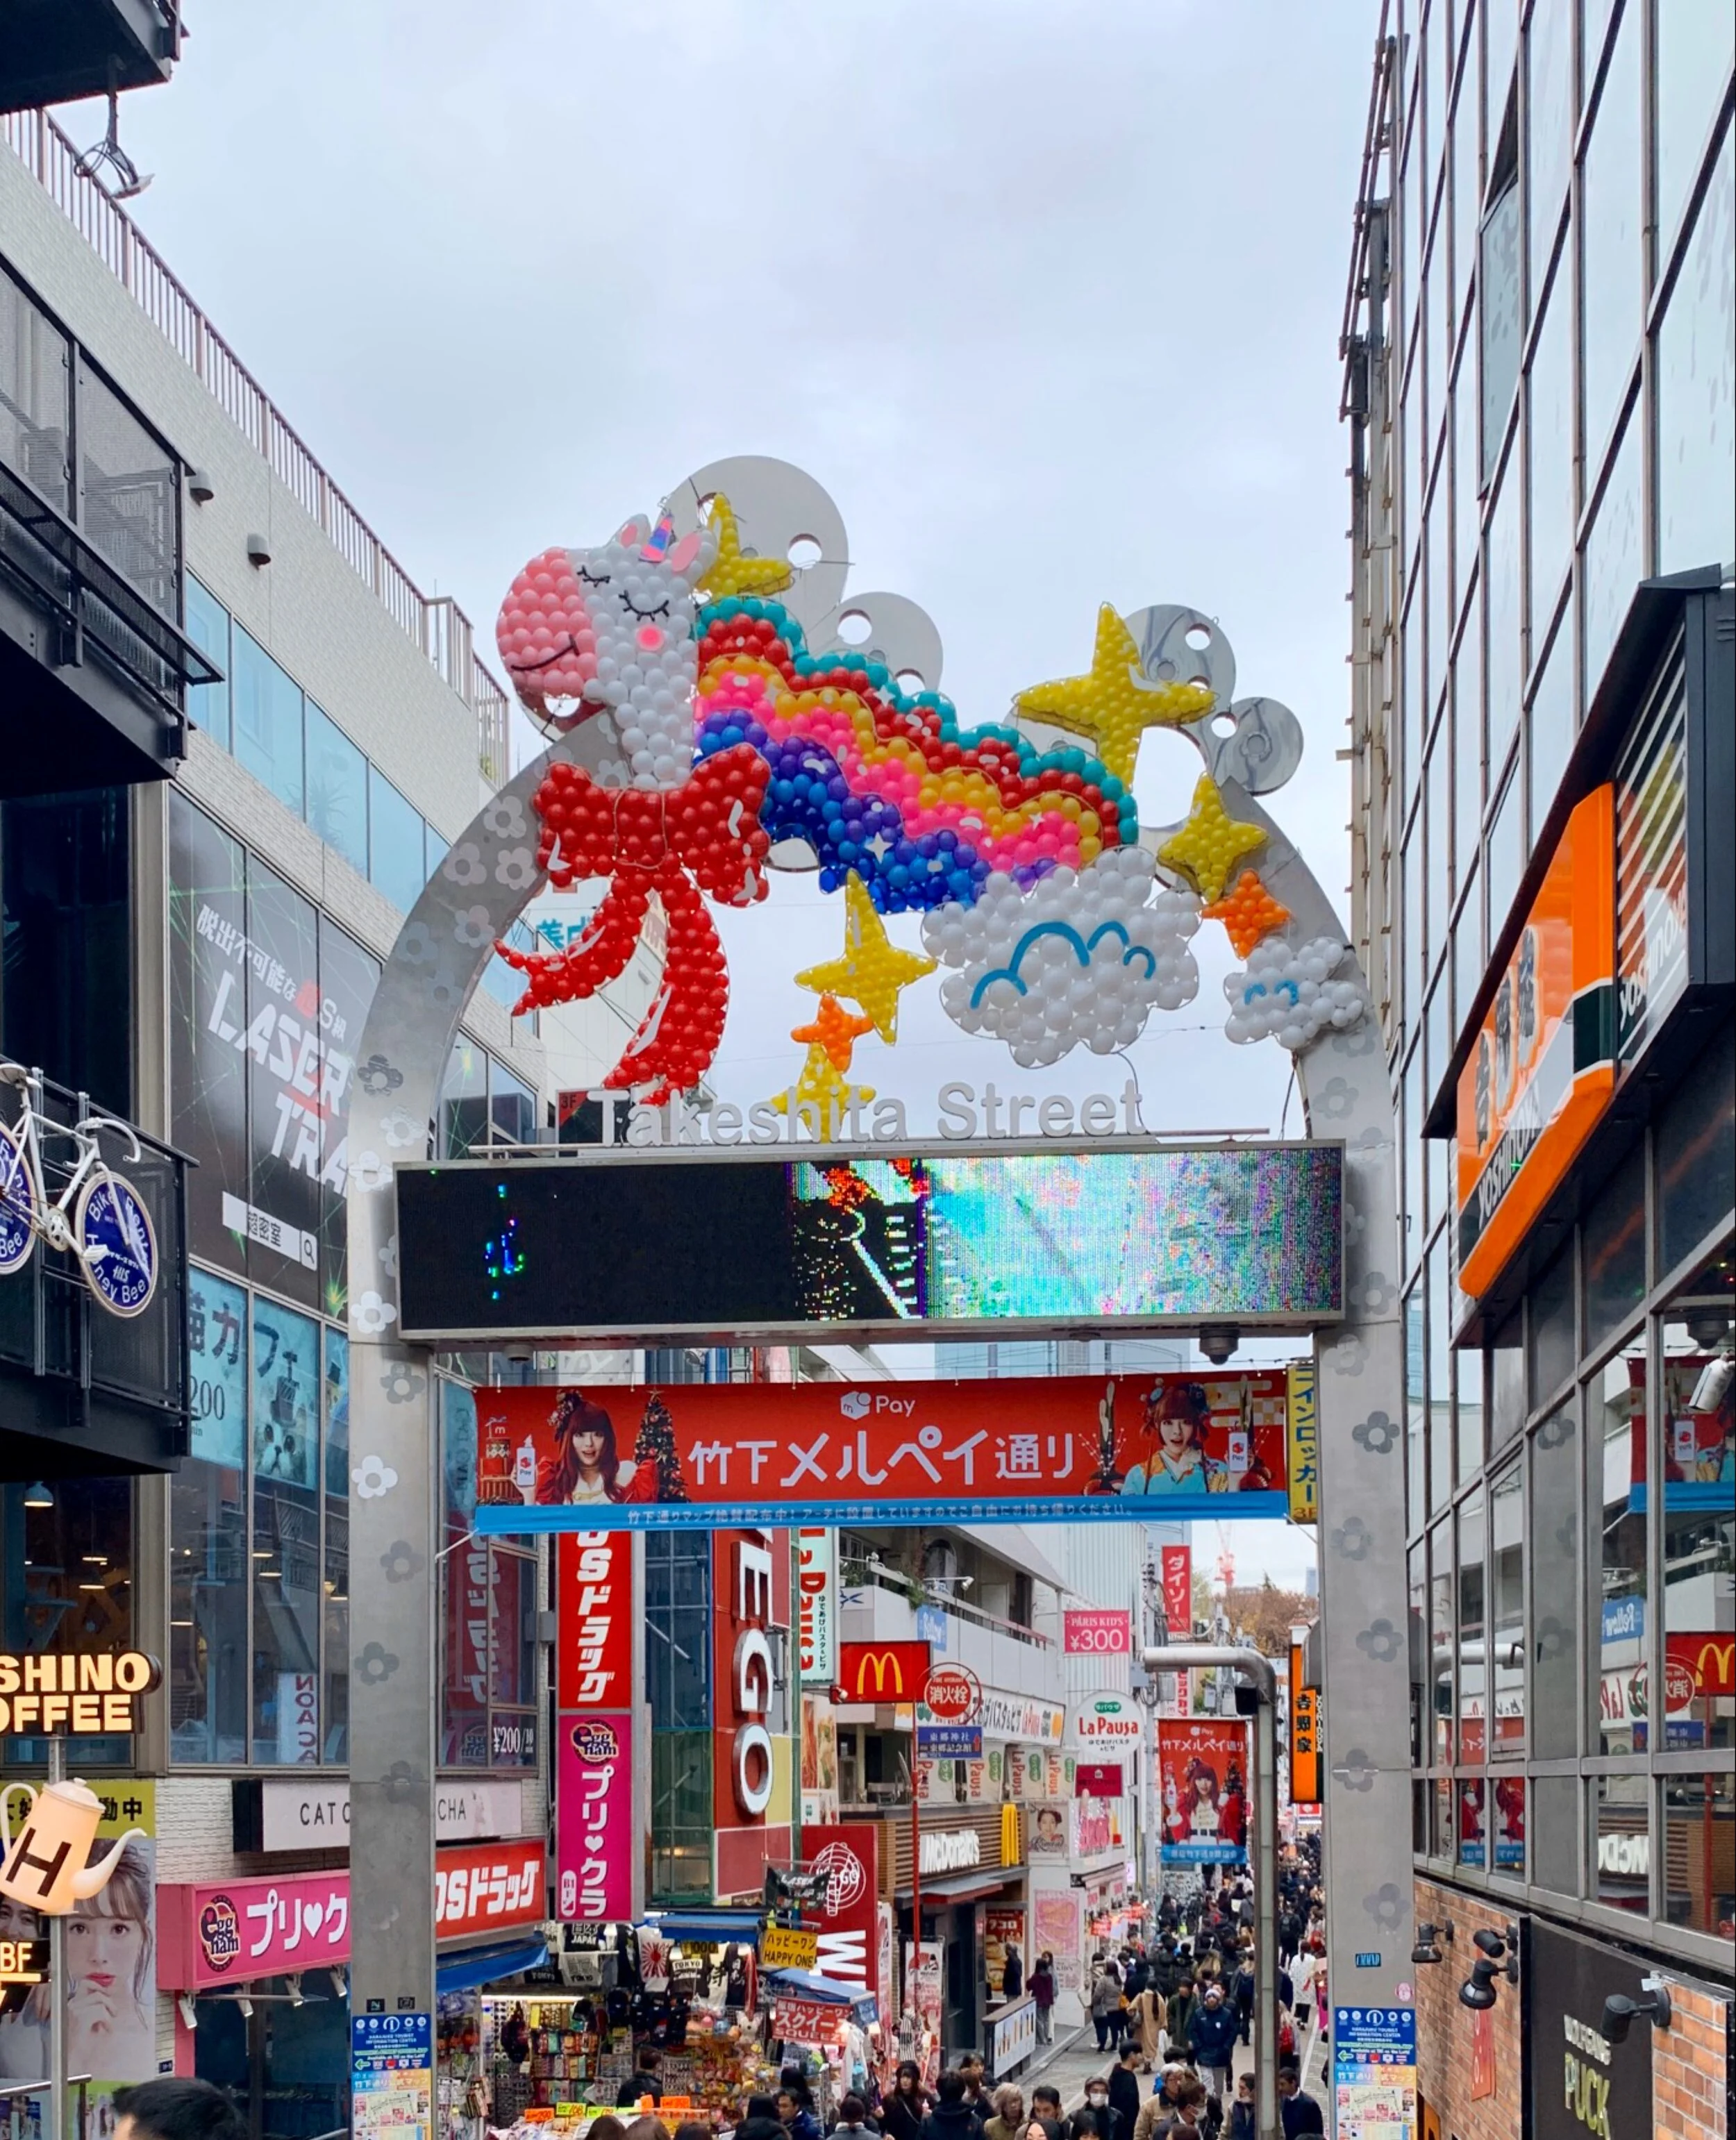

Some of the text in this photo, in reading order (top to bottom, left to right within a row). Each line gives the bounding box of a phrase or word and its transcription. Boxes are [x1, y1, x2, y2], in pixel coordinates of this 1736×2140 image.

[208, 970, 349, 1116] LASER
[560, 1094, 576, 1109] 3F
[587, 1079, 1146, 1147] Takeshita Street
[876, 1395, 916, 1417] Pay
[687, 1425, 1073, 1487] 竹下メルペイ通り
[1168, 1555, 1185, 1615] ダイソー
[1071, 1616, 1098, 1627] PARIS
[1069, 1629, 1124, 1651] ¥300
[736, 1529, 774, 1815] EGO
[929, 1685, 968, 1705] 消火栓
[1079, 1716, 1139, 1736] La Pausa
[299, 1803, 336, 1826] CAT
[6, 1827, 72, 1898] H
[920, 1830, 980, 1874] McDonald's
[766, 1932, 816, 1950] ハッピーワン
[764, 1951, 814, 1969] HAPPY ONE
[1564, 2052, 1611, 2140] PUCK
